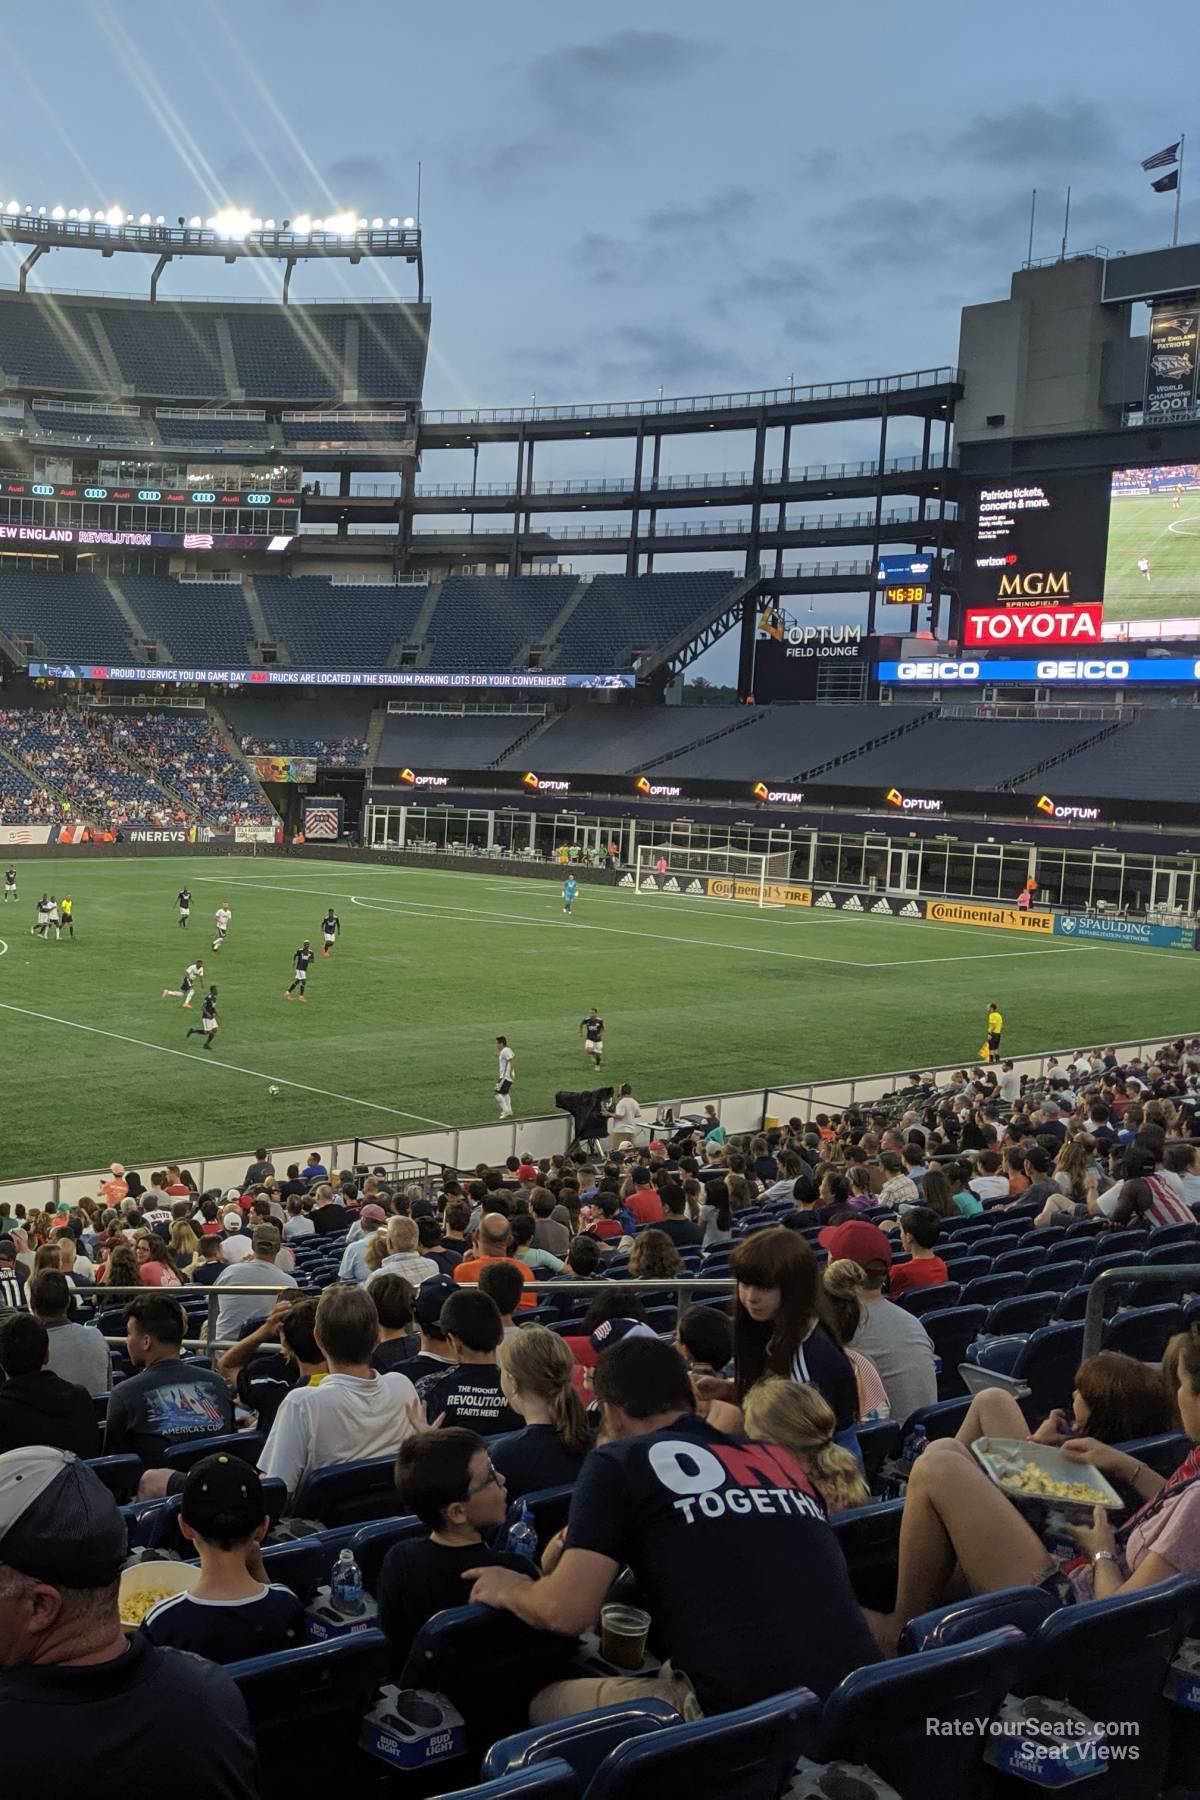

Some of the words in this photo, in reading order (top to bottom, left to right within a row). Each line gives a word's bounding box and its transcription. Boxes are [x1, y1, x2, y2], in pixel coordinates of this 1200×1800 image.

[1157, 340, 1191, 350] PATRIOTS
[1156, 384, 1183, 392] WORLD
[1149, 390, 1191, 401] CHAMPIONS
[1150, 397, 1188, 411] 2001
[7, 485, 25, 493] Audi
[59, 489, 77, 497] Audi
[113, 491, 130, 499] Audi
[980, 490, 1013, 501] Patriots
[1013, 487, 1044, 498] tickets,
[167, 494, 184, 502] Audi
[222, 495, 240, 503] Audi
[277, 497, 294, 505] Audi
[980, 500, 1016, 511] concerts
[1017, 499, 1025, 509] &
[19, 527, 73, 542] ENGLAND
[78, 531, 151, 546] REVOLUTION
[998, 572, 1069, 595] MGM
[888, 587, 923, 602] 46:38
[971, 612, 1097, 639] TOYOTA
[788, 624, 861, 645] OPTUM
[786, 647, 814, 657] FIELD
[816, 646, 859, 656] LOUNGE
[897, 662, 980, 679] GEICO
[1037, 661, 1129, 679] GEICO
[110, 667, 135, 678] PROUD
[136, 668, 146, 678] TO
[147, 668, 177, 680] SERVICE
[178, 670, 194, 680] YOU
[195, 671, 206, 680] ON
[207, 671, 229, 681] GAME
[230, 672, 247, 681] DAY.
[269, 673, 299, 682] TRUCKS
[300, 673, 315, 683] ARE
[317, 673, 351, 683] LOCATED
[352, 674, 361, 684] IN
[362, 674, 377, 684] THE
[378, 674, 413, 684] STADIUM
[414, 674, 449, 685] PARKING
[450, 675, 470, 685] LOTS
[471, 675, 488, 685] FOR
[489, 676, 510, 685] YOUR
[512, 676, 567, 686] CONVENIENCE
[415, 776, 448, 785] OPTUM
[538, 781, 569, 790] OPTUM
[650, 785, 680, 795] OPTUM
[768, 792, 803, 802] OPTUM
[902, 798, 942, 810] OPTUM
[1055, 806, 1099, 819] OPTUM
[130, 831, 186, 842] #NEREVS
[783, 890, 809, 902] TIRE
[931, 903, 1005, 924] Continental
[1020, 916, 1050, 929] TIRE
[1079, 917, 1151, 935] SPAULDING
[457, 1385, 471, 1393] THE
[472, 1386, 498, 1394] HOCKEY
[447, 1395, 509, 1407] REVOLUTION
[456, 1407, 480, 1416] STARTS
[480, 1409, 499, 1417] HERE!
[380, 1735, 398, 1748] BUD
[430, 1733, 451, 1747] BUD
[377, 1741, 401, 1757] LIGHT
[425, 1741, 454, 1756] LIGHT
[1009, 1757, 1044, 1774] LIGHT
